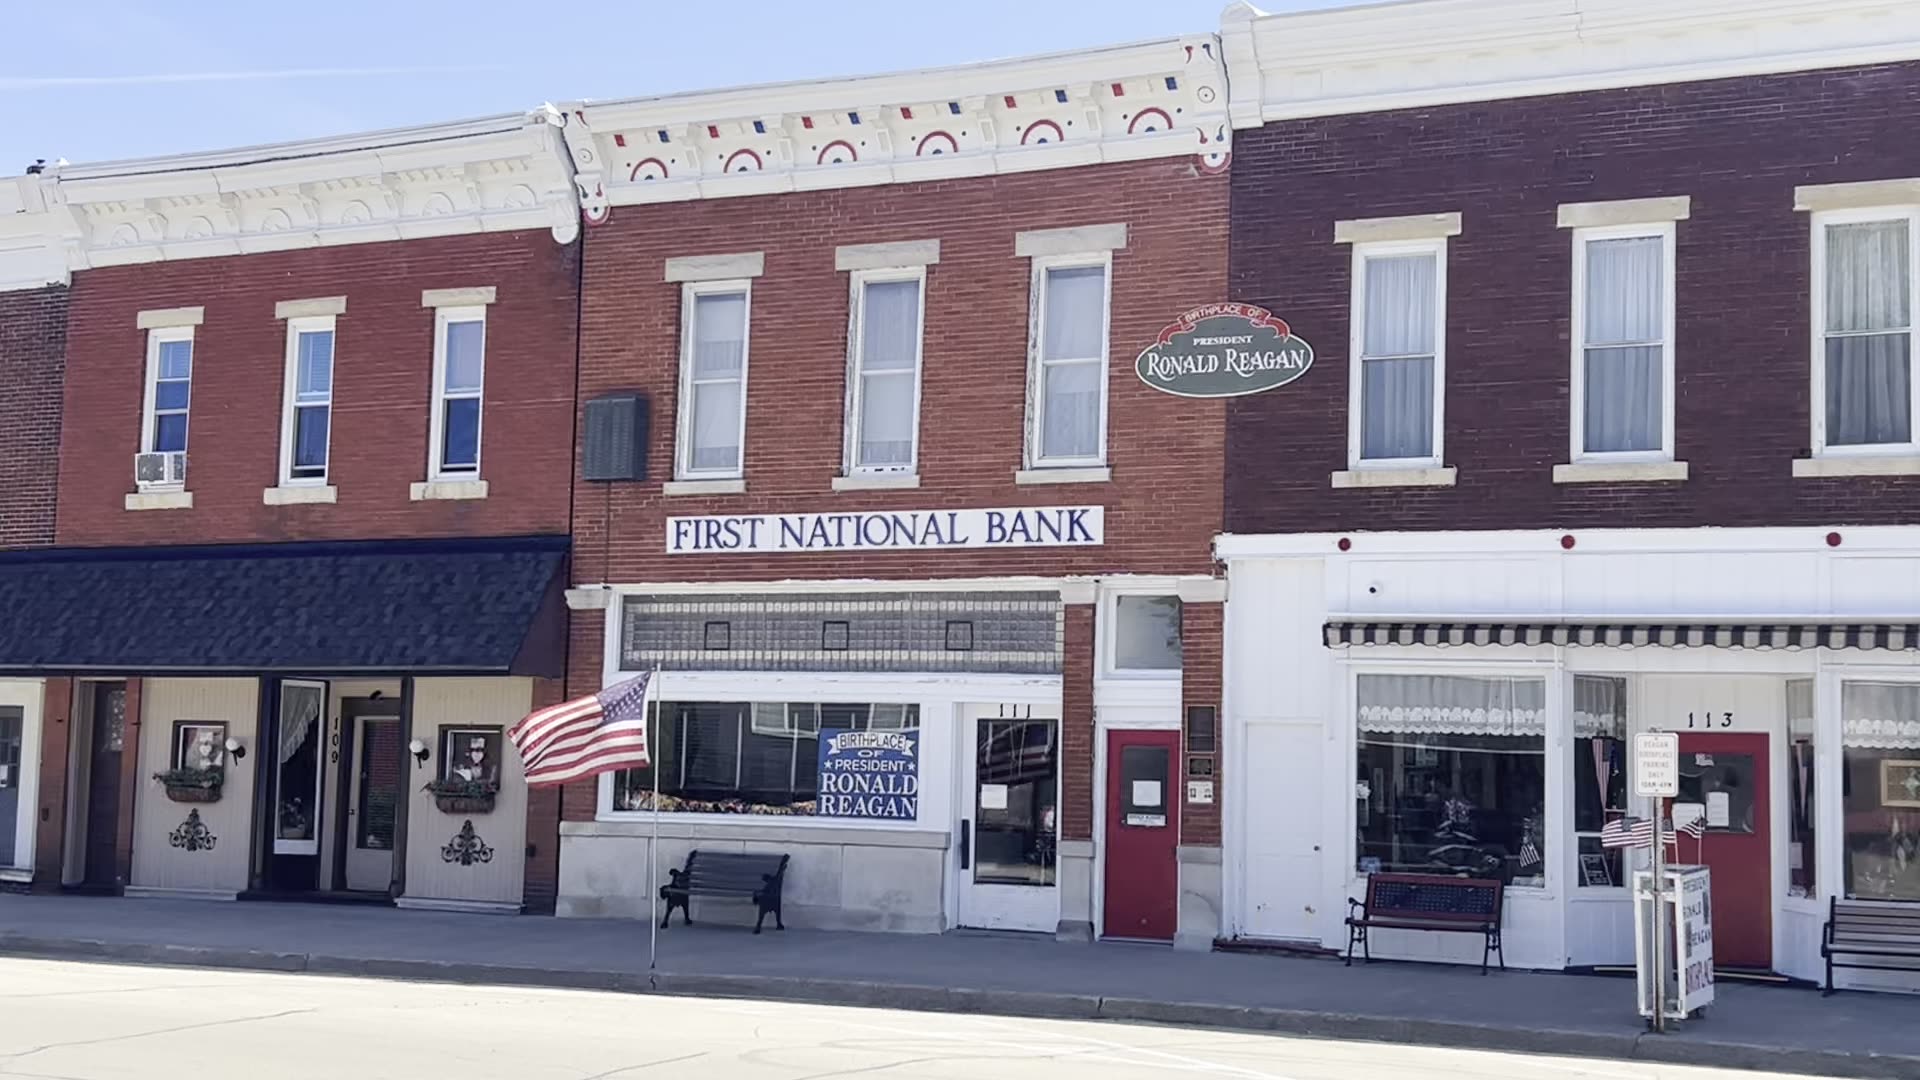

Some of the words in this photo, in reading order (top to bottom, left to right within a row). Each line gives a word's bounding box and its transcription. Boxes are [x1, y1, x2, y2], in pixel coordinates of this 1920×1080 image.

[1185, 306, 1241, 322] BIRTHPLACE
[1247, 308, 1262, 318] OF
[1193, 335, 1253, 346] PRESIDENT
[1147, 352, 1219, 381] RONALD
[1224, 348, 1305, 378] REAGAN
[673, 517, 765, 550] FIRST
[779, 512, 969, 550] NATIONAL
[985, 508, 1095, 545] BANK
[1688, 712, 1733, 728] 113
[839, 733, 907, 750] BIRTHPLACE
[858, 750, 884, 758] OF
[834, 759, 906, 772] PRESIDENT
[820, 772, 918, 795] RONALD
[819, 794, 917, 818] REAGAN
